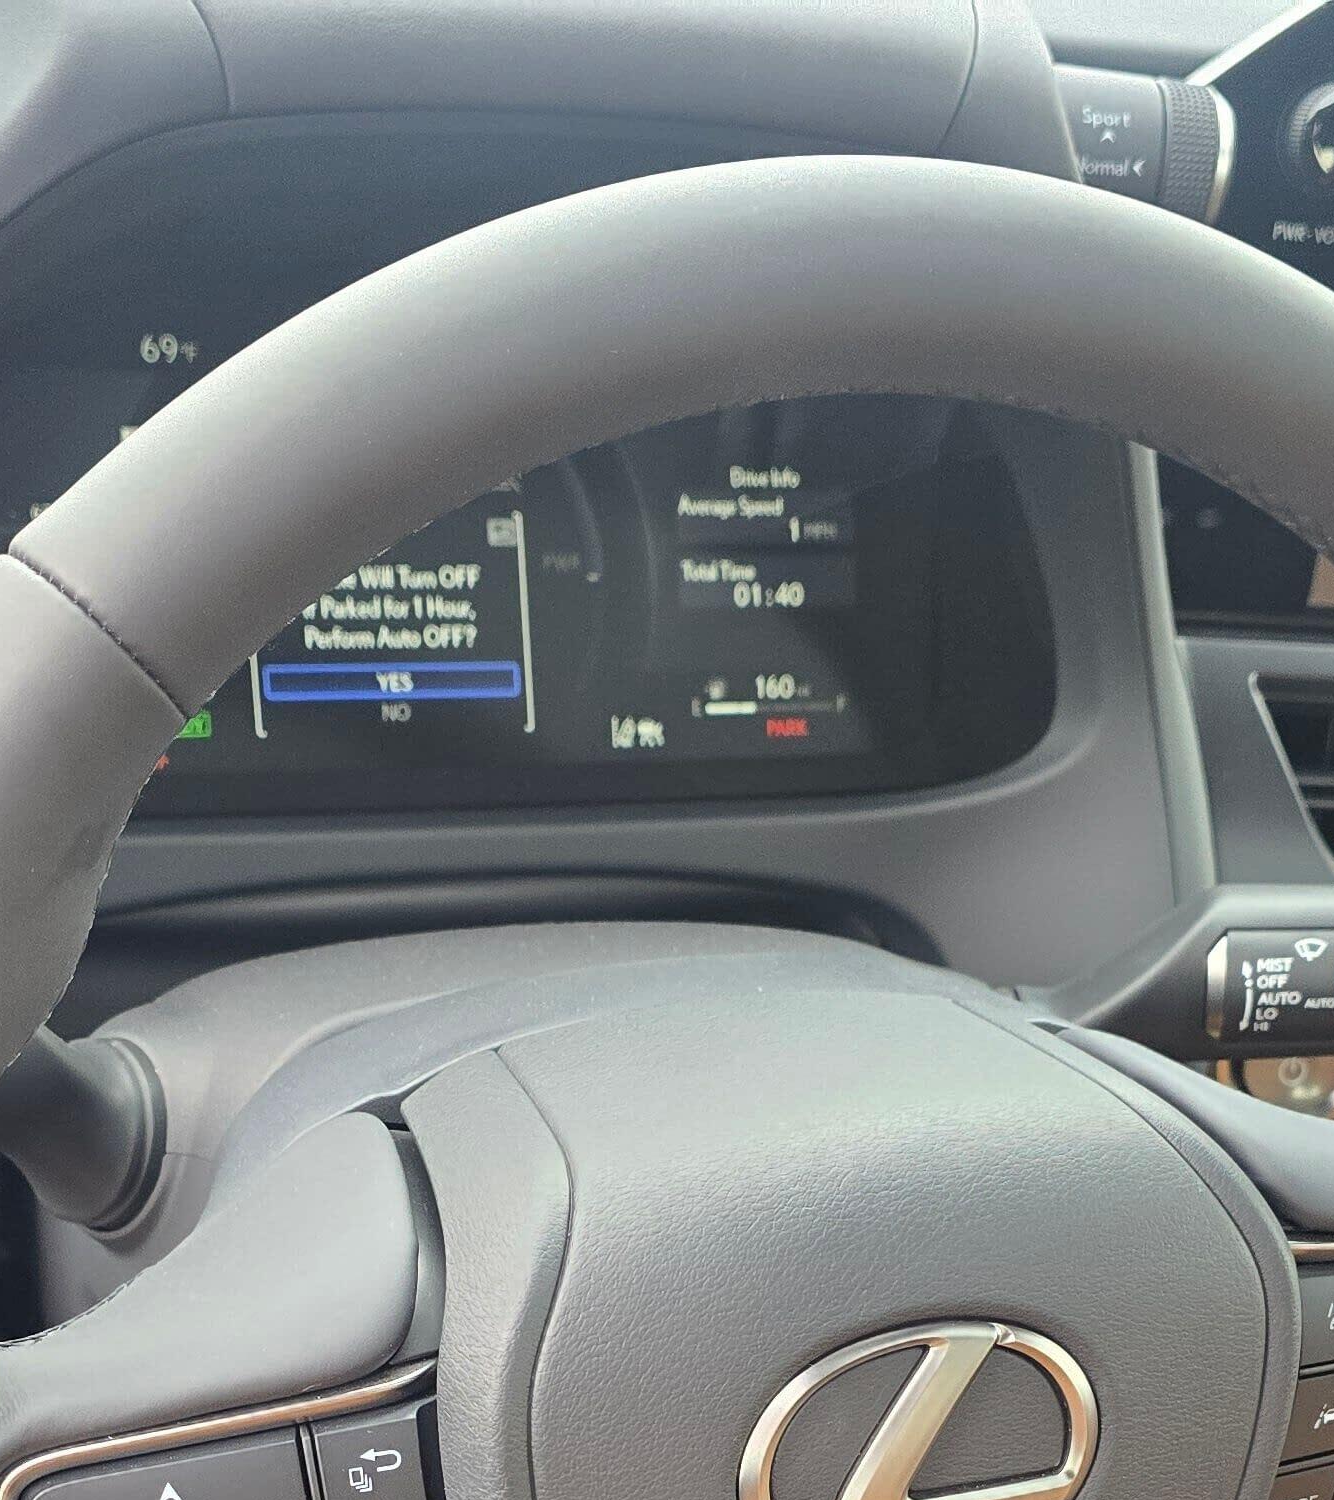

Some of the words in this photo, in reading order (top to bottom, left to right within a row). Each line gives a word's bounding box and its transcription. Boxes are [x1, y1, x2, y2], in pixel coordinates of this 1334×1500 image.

[1082, 106, 1131, 128] Sport
[677, 492, 736, 520] Average
[737, 494, 784, 519] Speed
[789, 516, 800, 543] 1
[358, 564, 395, 590] Will
[395, 563, 438, 590] Turn
[438, 563, 482, 590] OFF
[319, 593, 382, 620] Parked
[733, 581, 805, 608] 01:40
[303, 624, 376, 650] Perform
[376, 624, 422, 650] Auto
[423, 623, 478, 650] OFF?
[376, 671, 414, 693] YES
[755, 673, 795, 699] 160
[381, 703, 412, 722] NO
[1256, 957, 1294, 973] MIST
[1256, 974, 1289, 989] OFF
[1257, 990, 1302, 1006] AUTO
[1255, 1007, 1280, 1021] LO
